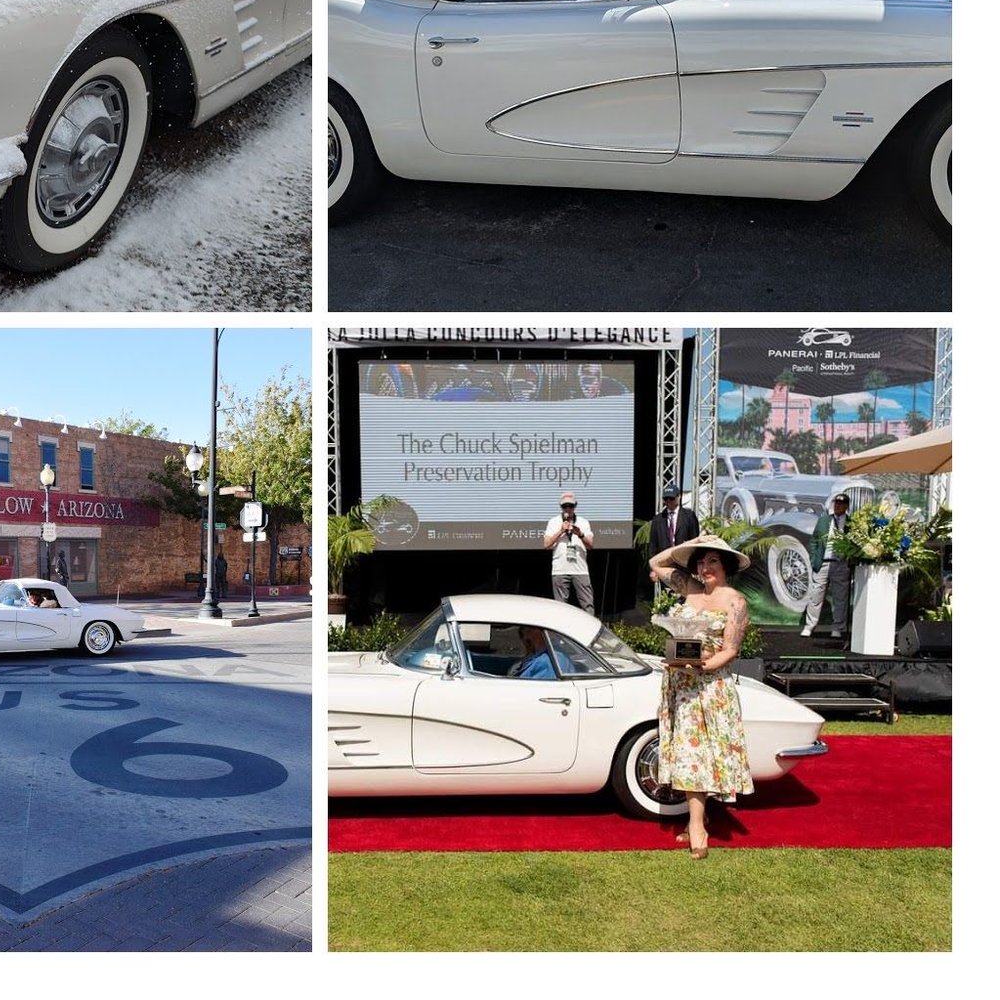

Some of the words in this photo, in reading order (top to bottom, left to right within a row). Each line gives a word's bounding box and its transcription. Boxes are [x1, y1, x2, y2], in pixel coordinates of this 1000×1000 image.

[768, 349, 818, 358] PANERAI
[834, 351, 848, 359] LPL
[849, 350, 880, 359] Financial
[792, 364, 814, 373] Pacific
[397, 432, 433, 455] The
[439, 432, 501, 455] Chuck
[508, 432, 599, 460] Spielman
[403, 461, 522, 482] Preservation
[528, 458, 594, 488] Trophy
[56, 500, 125, 519] ARIZONA
